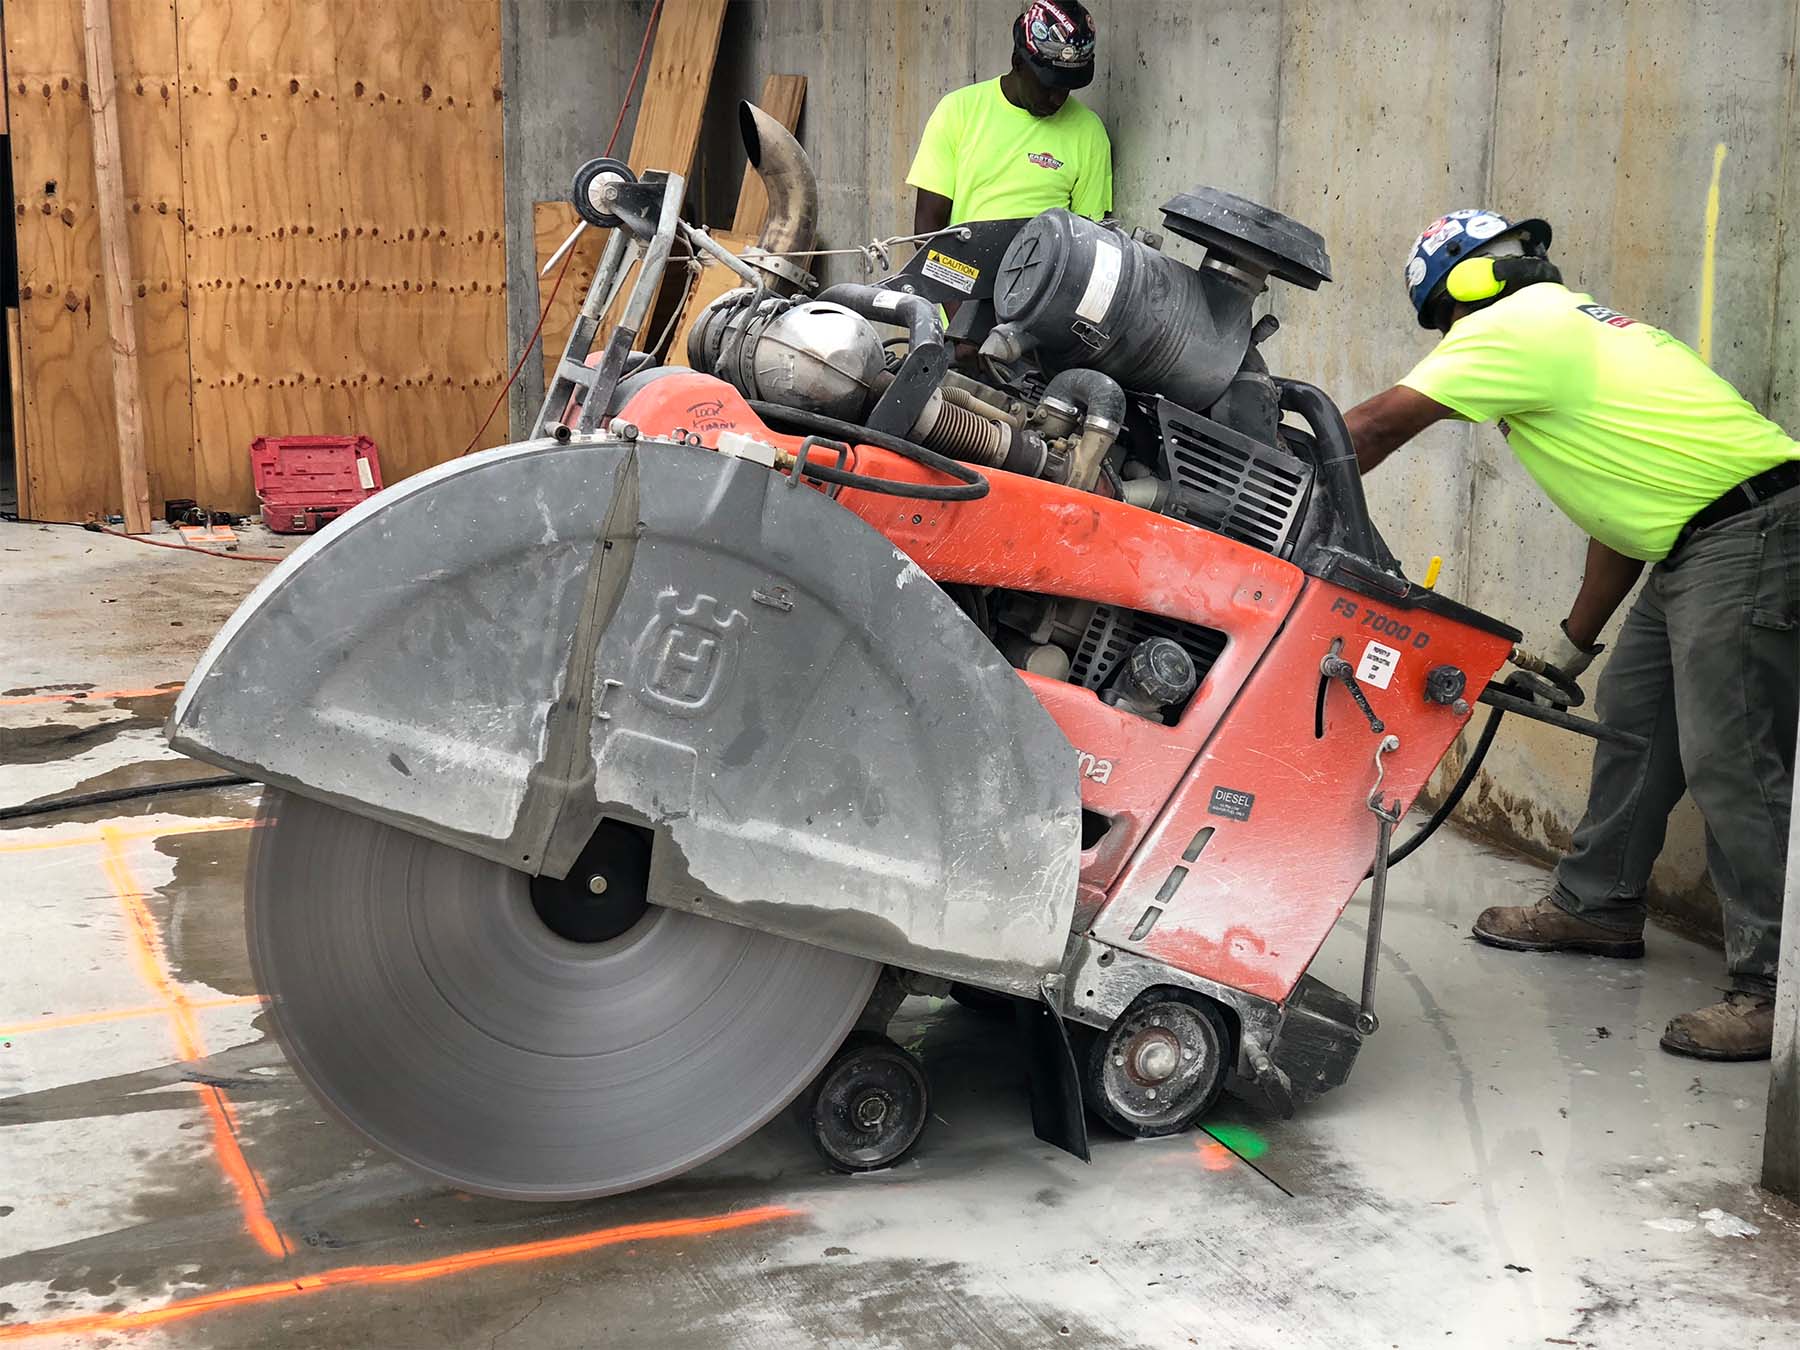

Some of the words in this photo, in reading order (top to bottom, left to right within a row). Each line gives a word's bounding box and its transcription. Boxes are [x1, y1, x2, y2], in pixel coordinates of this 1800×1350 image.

[942, 256, 975, 276] CAUTION
[1330, 597, 1358, 619] FS
[1361, 609, 1412, 641] 7000
[1412, 631, 1431, 649] D
[1075, 750, 1113, 785] na
[1215, 790, 1250, 807] DIESEL
